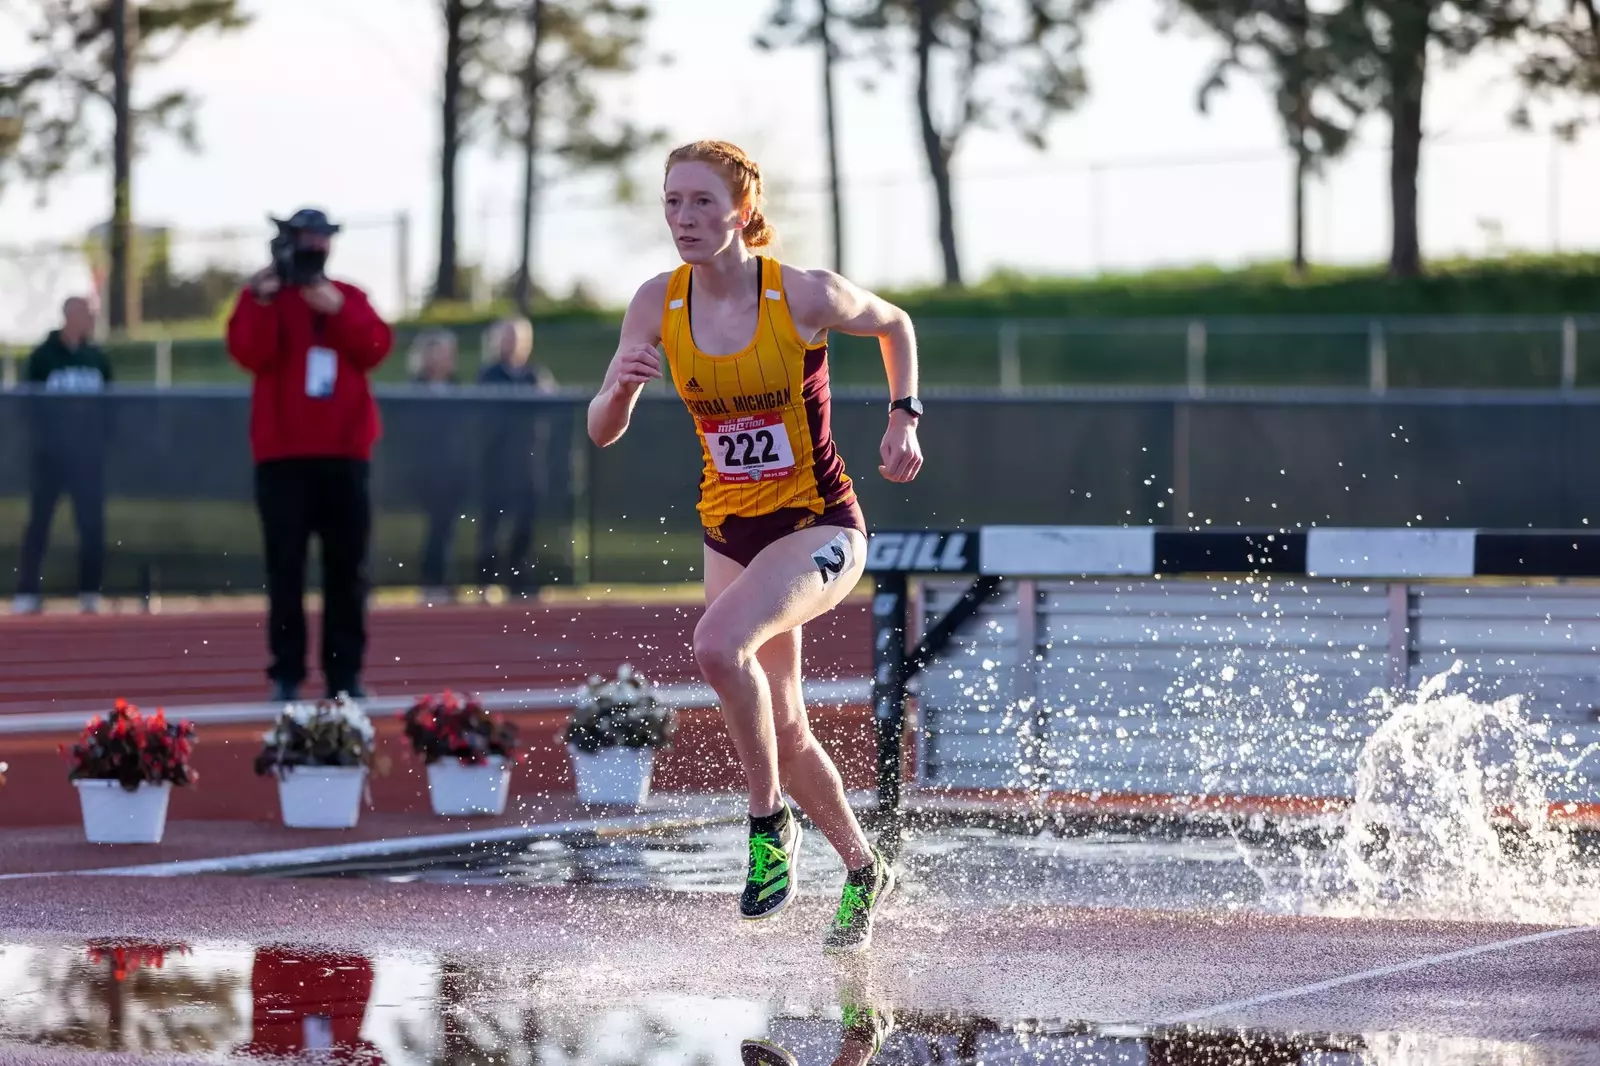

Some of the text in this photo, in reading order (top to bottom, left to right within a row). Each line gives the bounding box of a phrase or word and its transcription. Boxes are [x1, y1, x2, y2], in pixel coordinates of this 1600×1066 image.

[732, 387, 791, 413] MICHIGAN
[718, 429, 780, 467] 222
[813, 545, 846, 584] 2
[866, 533, 968, 570] GILL
